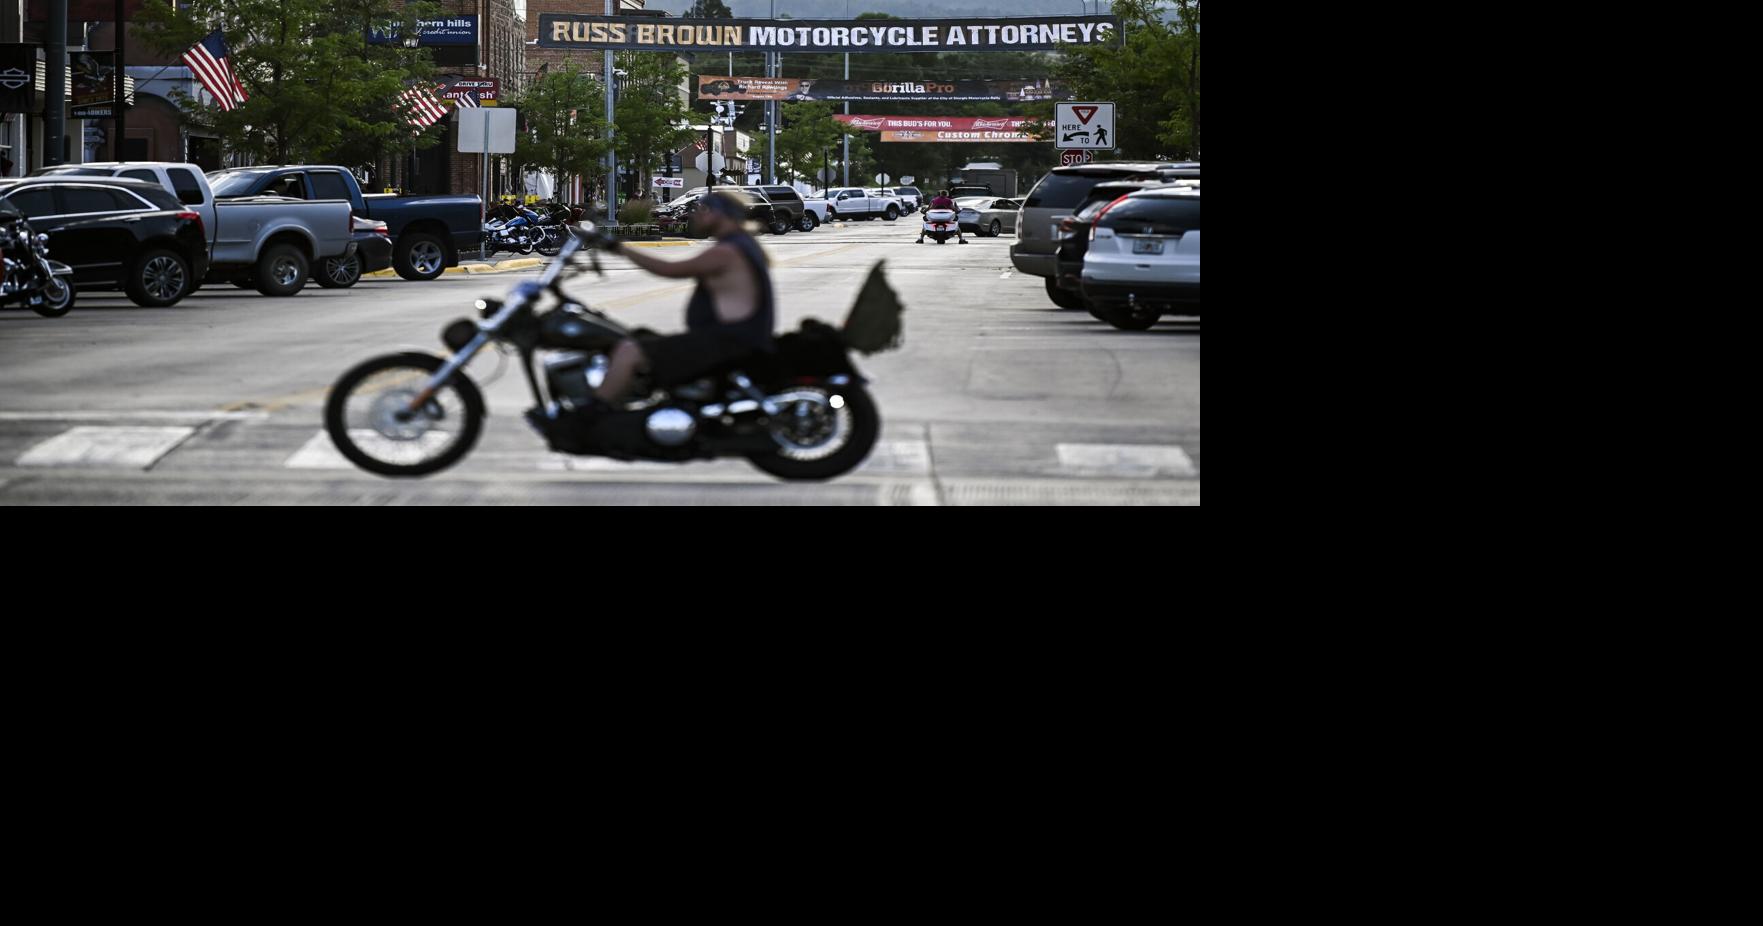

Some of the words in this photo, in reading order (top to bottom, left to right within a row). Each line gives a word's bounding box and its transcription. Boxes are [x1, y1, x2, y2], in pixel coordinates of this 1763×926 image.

[447, 20, 472, 28] hills
[552, 22, 626, 42] RUSS
[637, 24, 742, 45] BROWN
[749, 26, 939, 46] MOTORCYCLE
[946, 22, 1114, 46] ATTORNEYS
